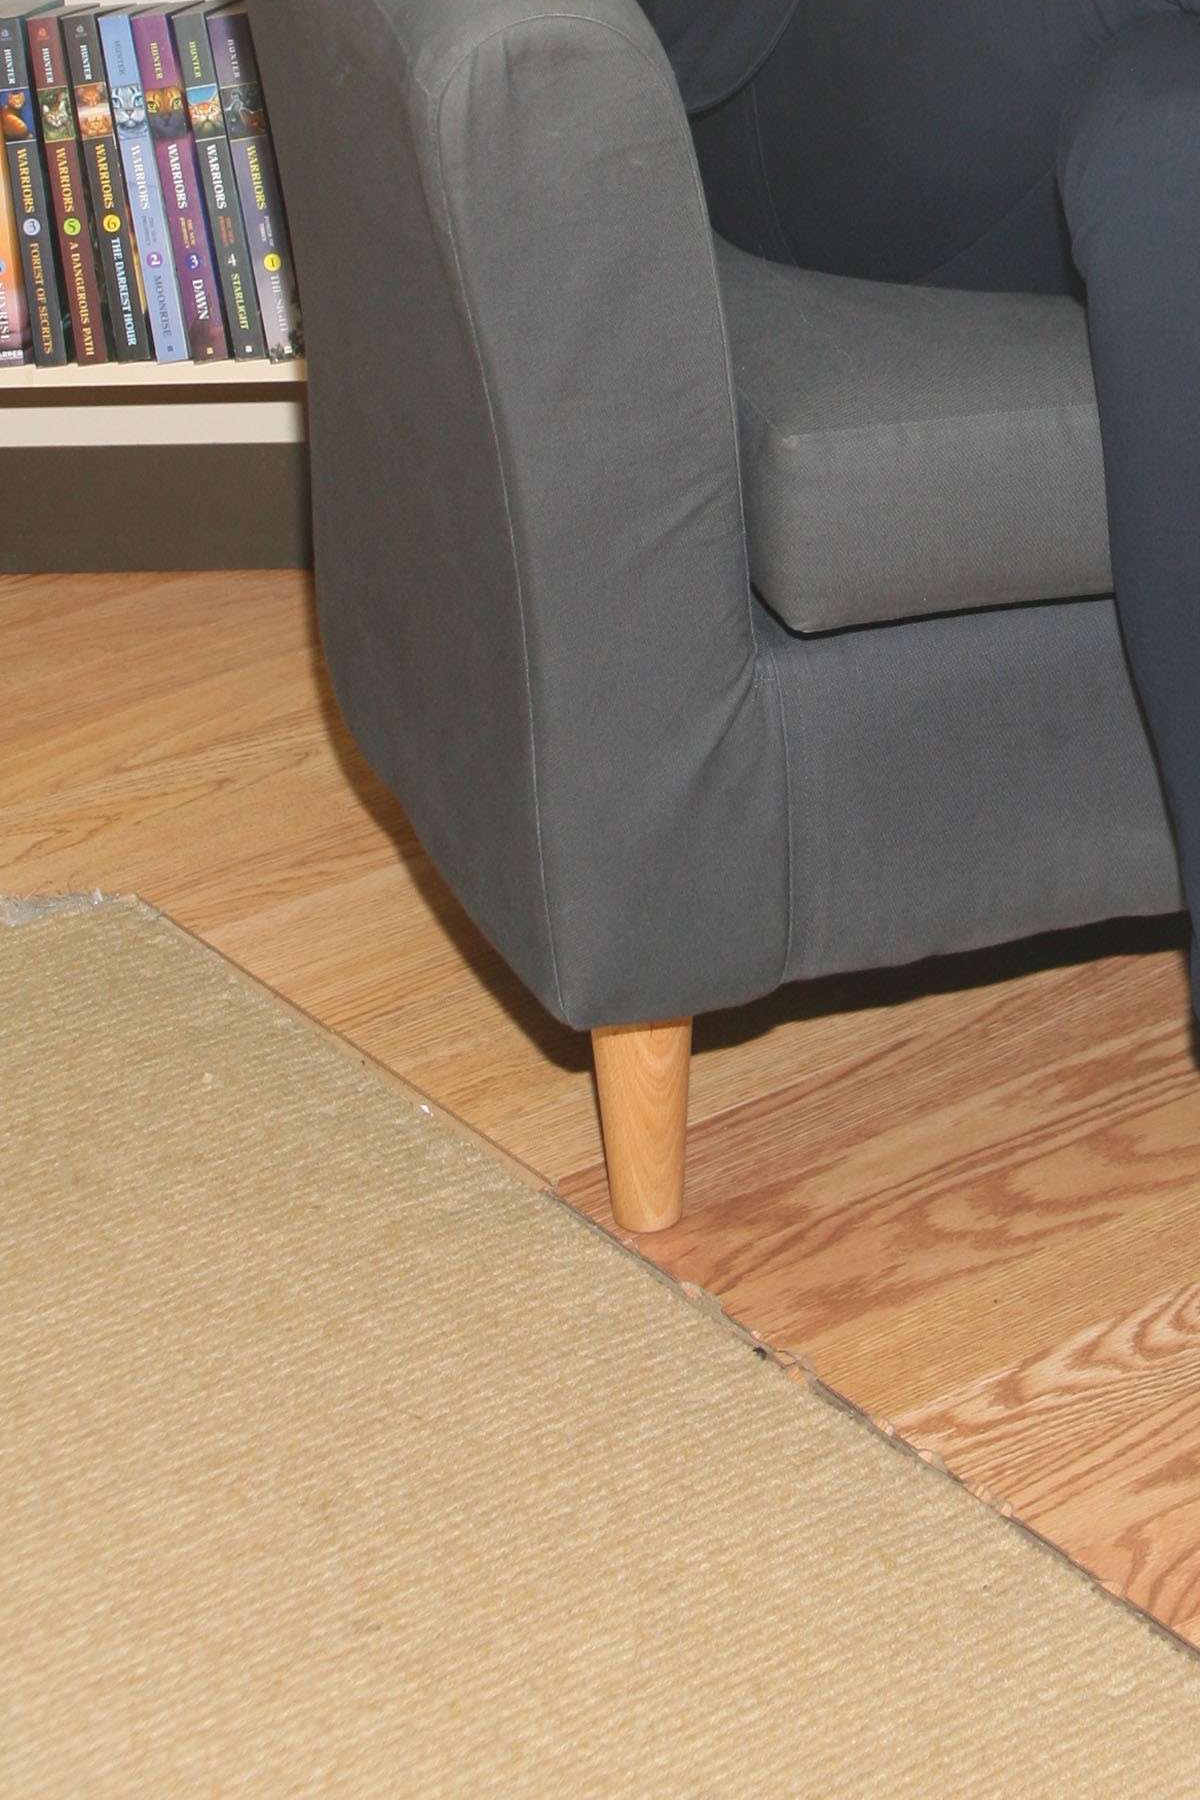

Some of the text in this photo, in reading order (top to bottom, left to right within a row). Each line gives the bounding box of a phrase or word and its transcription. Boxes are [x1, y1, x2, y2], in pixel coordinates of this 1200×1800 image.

[17, 148, 35, 213] WARRIORS
[56, 147, 74, 213] WARRIORS
[96, 144, 114, 209] WARRIORS
[168, 144, 187, 209] WARRIORS
[30, 243, 53, 354] FOREST OF SECRETS
[71, 252, 90, 324] DANGEROUS
[84, 325, 95, 356] PATH
[111, 237, 137, 346] THE DARKEST HOUR
[153, 274, 172, 336] MOONRISE
[192, 279, 210, 321] DAWN
[231, 273, 249, 330] STARLIGHT
